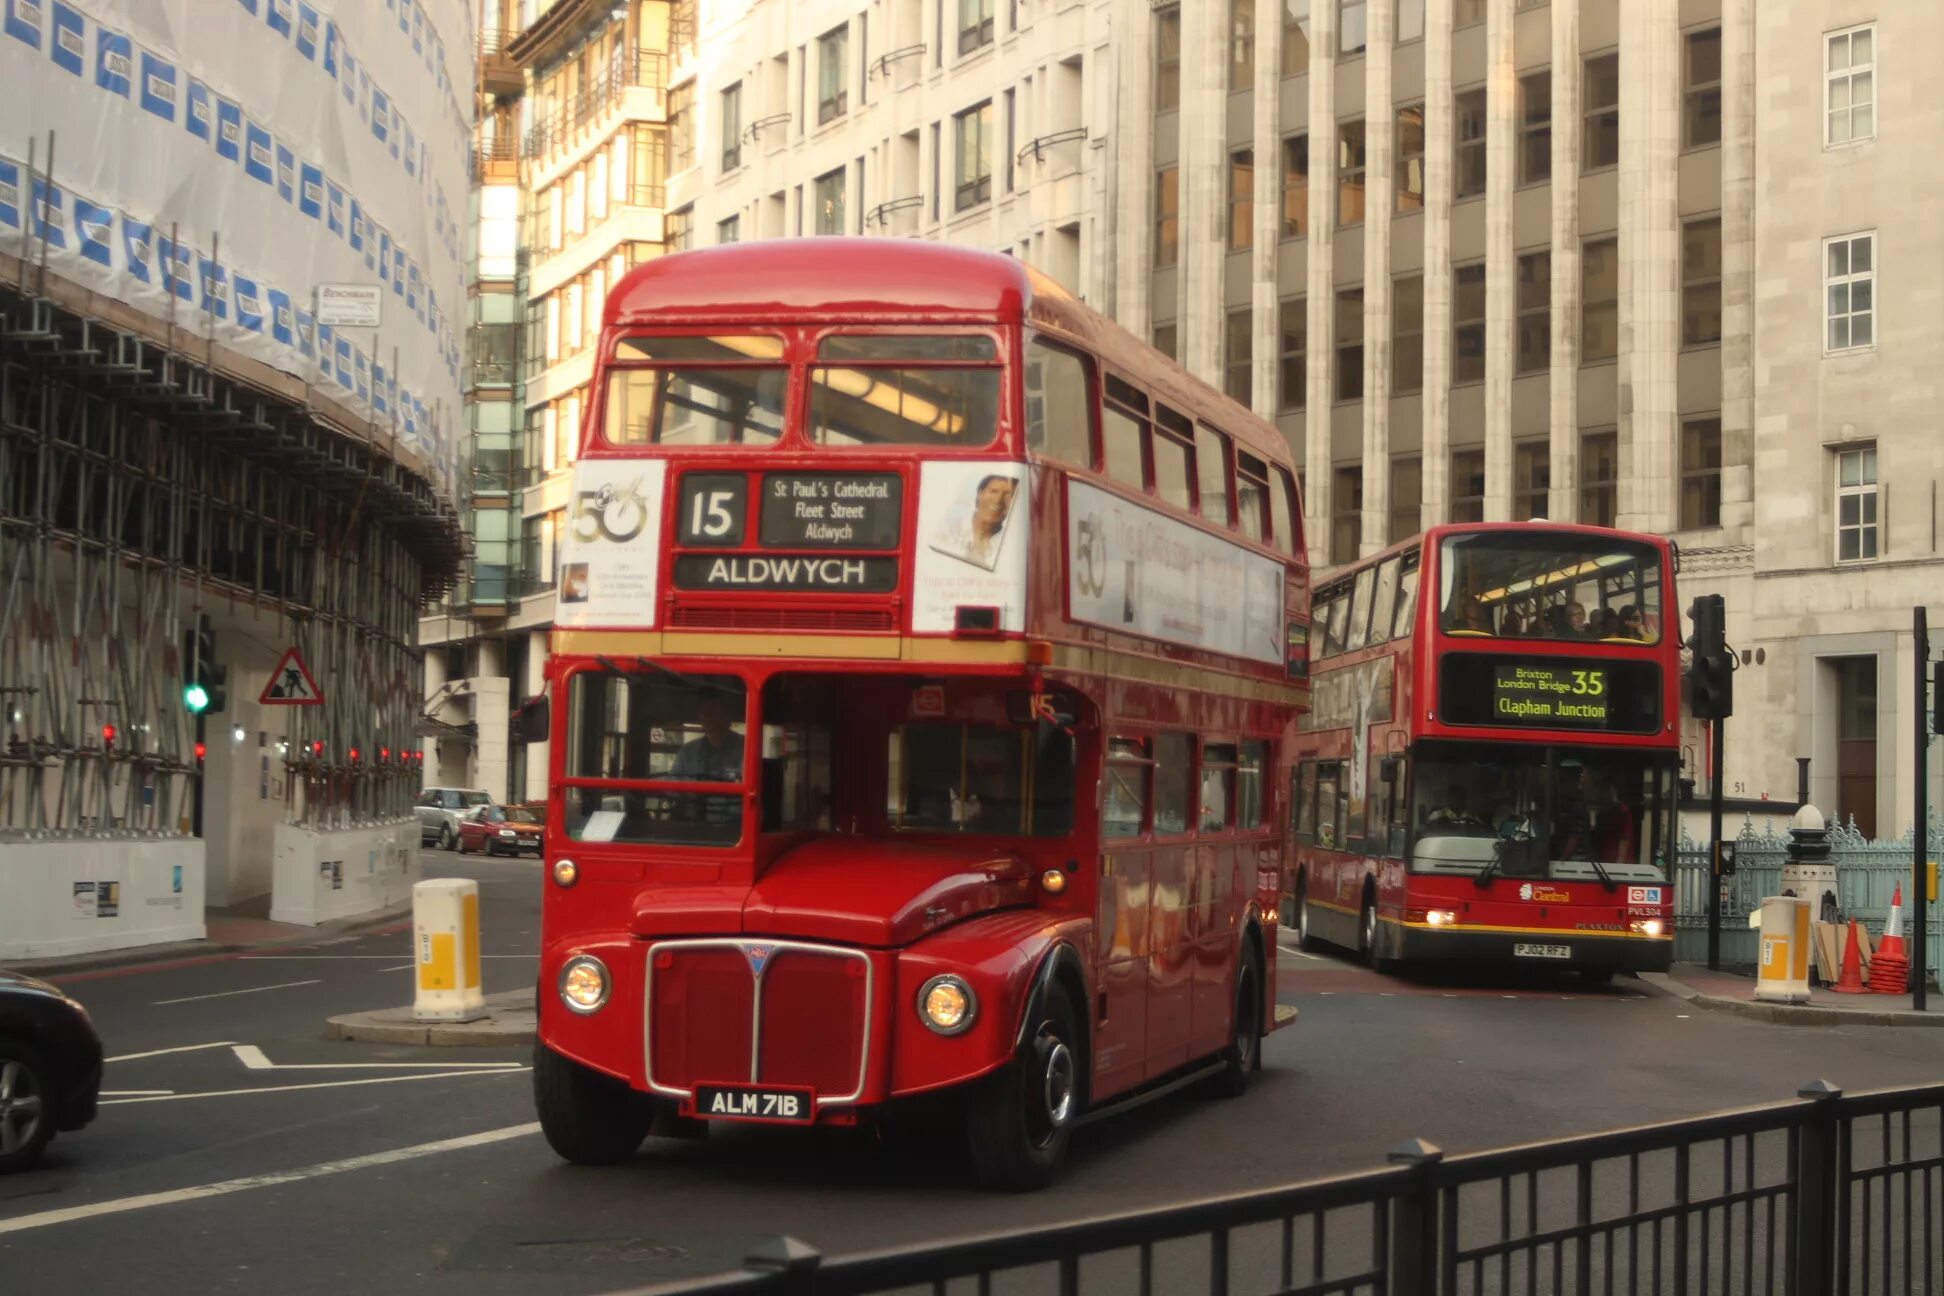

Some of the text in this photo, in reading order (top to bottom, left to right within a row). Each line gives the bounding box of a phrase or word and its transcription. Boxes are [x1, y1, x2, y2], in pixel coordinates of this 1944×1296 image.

[774, 480, 889, 498] St Paul's Cathedral
[691, 491, 734, 536] 15
[795, 501, 864, 519] Fleet Street
[805, 522, 853, 543] Aldwych
[708, 558, 865, 584] ALDWYCH
[1516, 668, 1552, 679] Brixton
[1571, 671, 1603, 695] 35
[1497, 678, 1571, 694] London Bridge
[1499, 697, 1605, 718] Clapham Junction
[1734, 781, 1745, 793] 51
[1517, 944, 1545, 956] PJ02
[711, 1092, 798, 1116] ALM 71B
